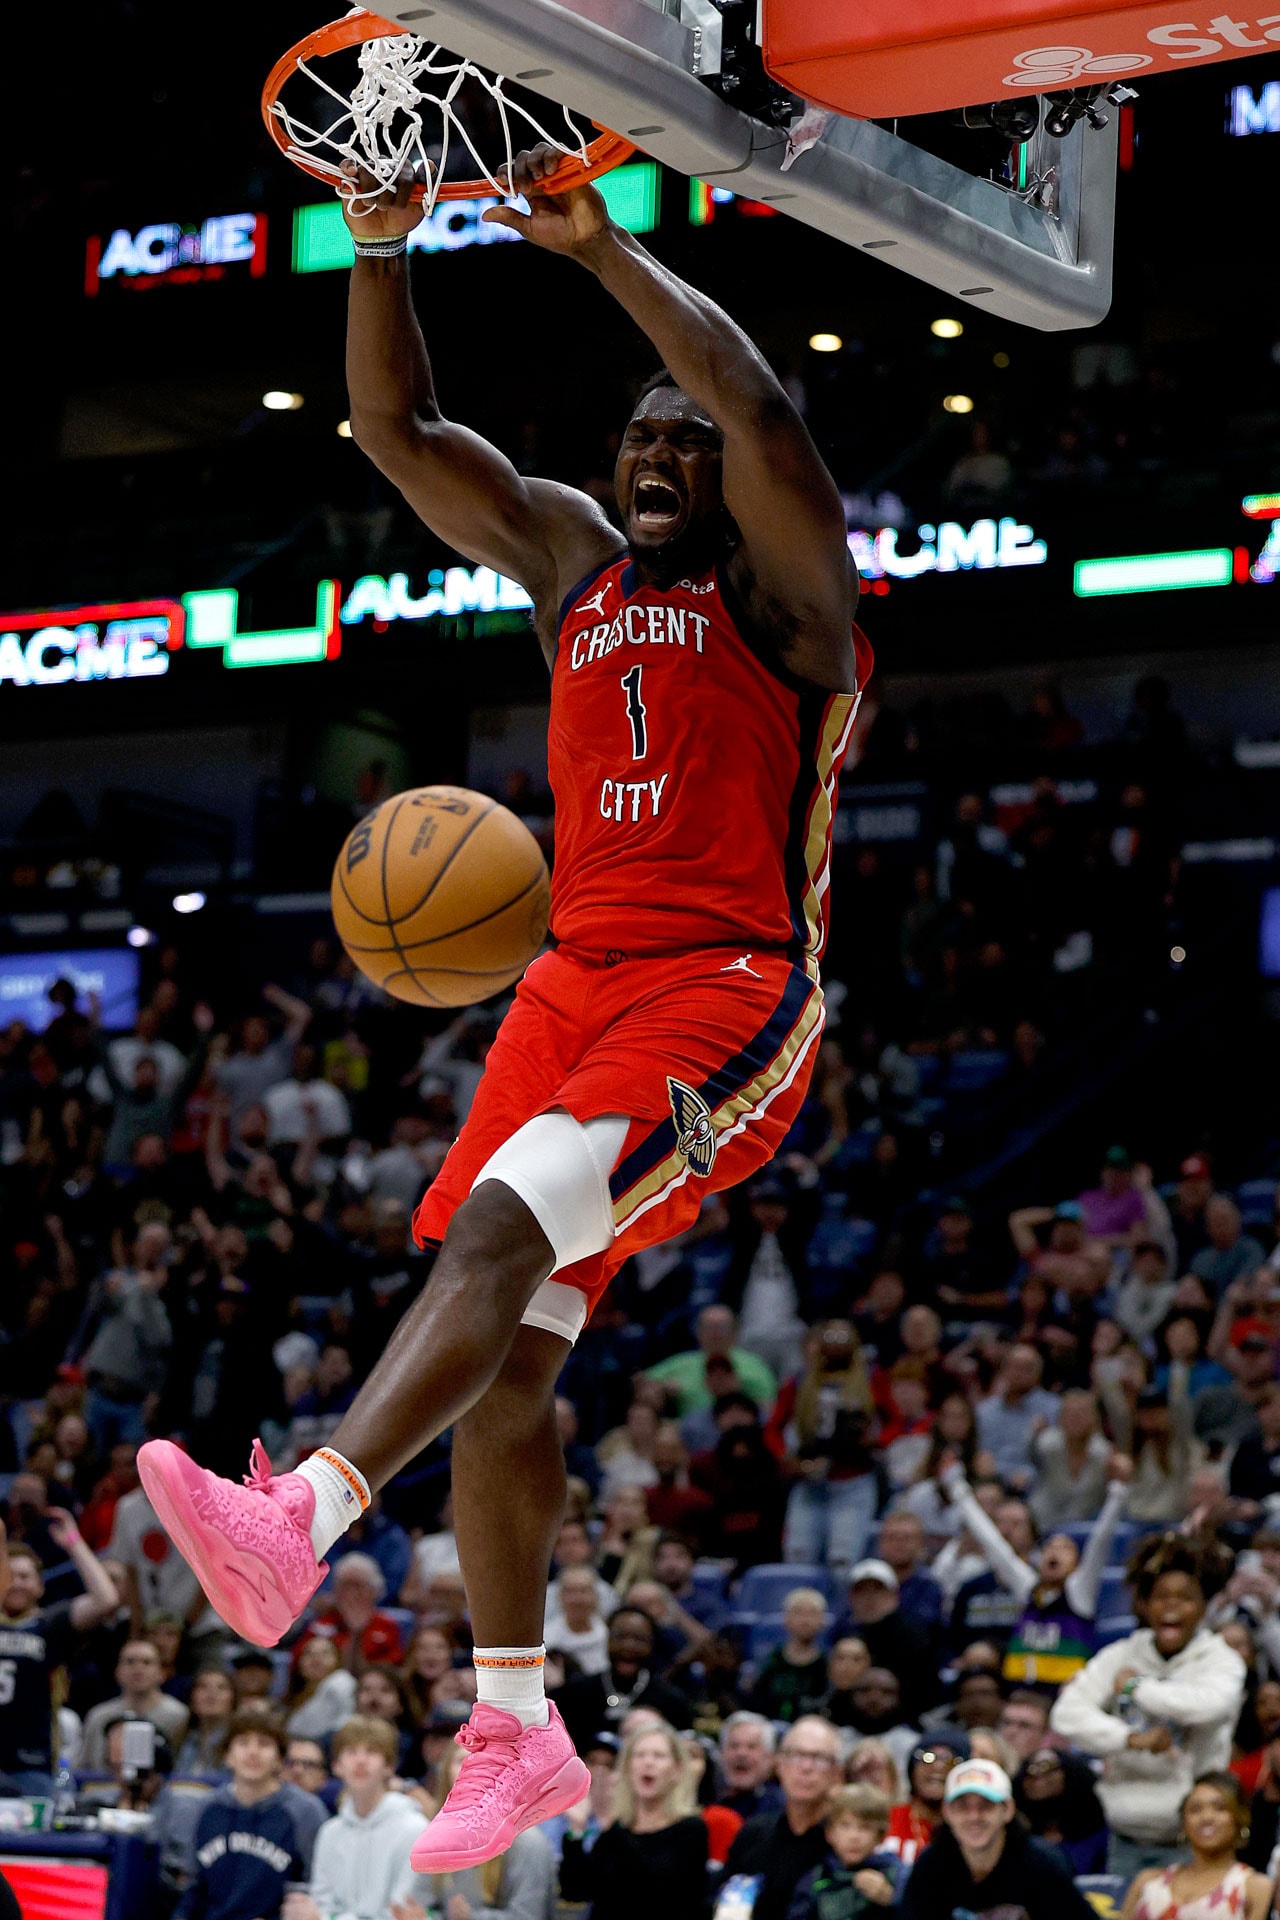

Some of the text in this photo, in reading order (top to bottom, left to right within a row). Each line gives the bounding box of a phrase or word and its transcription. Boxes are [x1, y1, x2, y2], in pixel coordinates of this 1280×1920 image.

[571, 604, 711, 672] CRESCENT
[620, 664, 648, 761] 1
[599, 772, 670, 823] CITY
